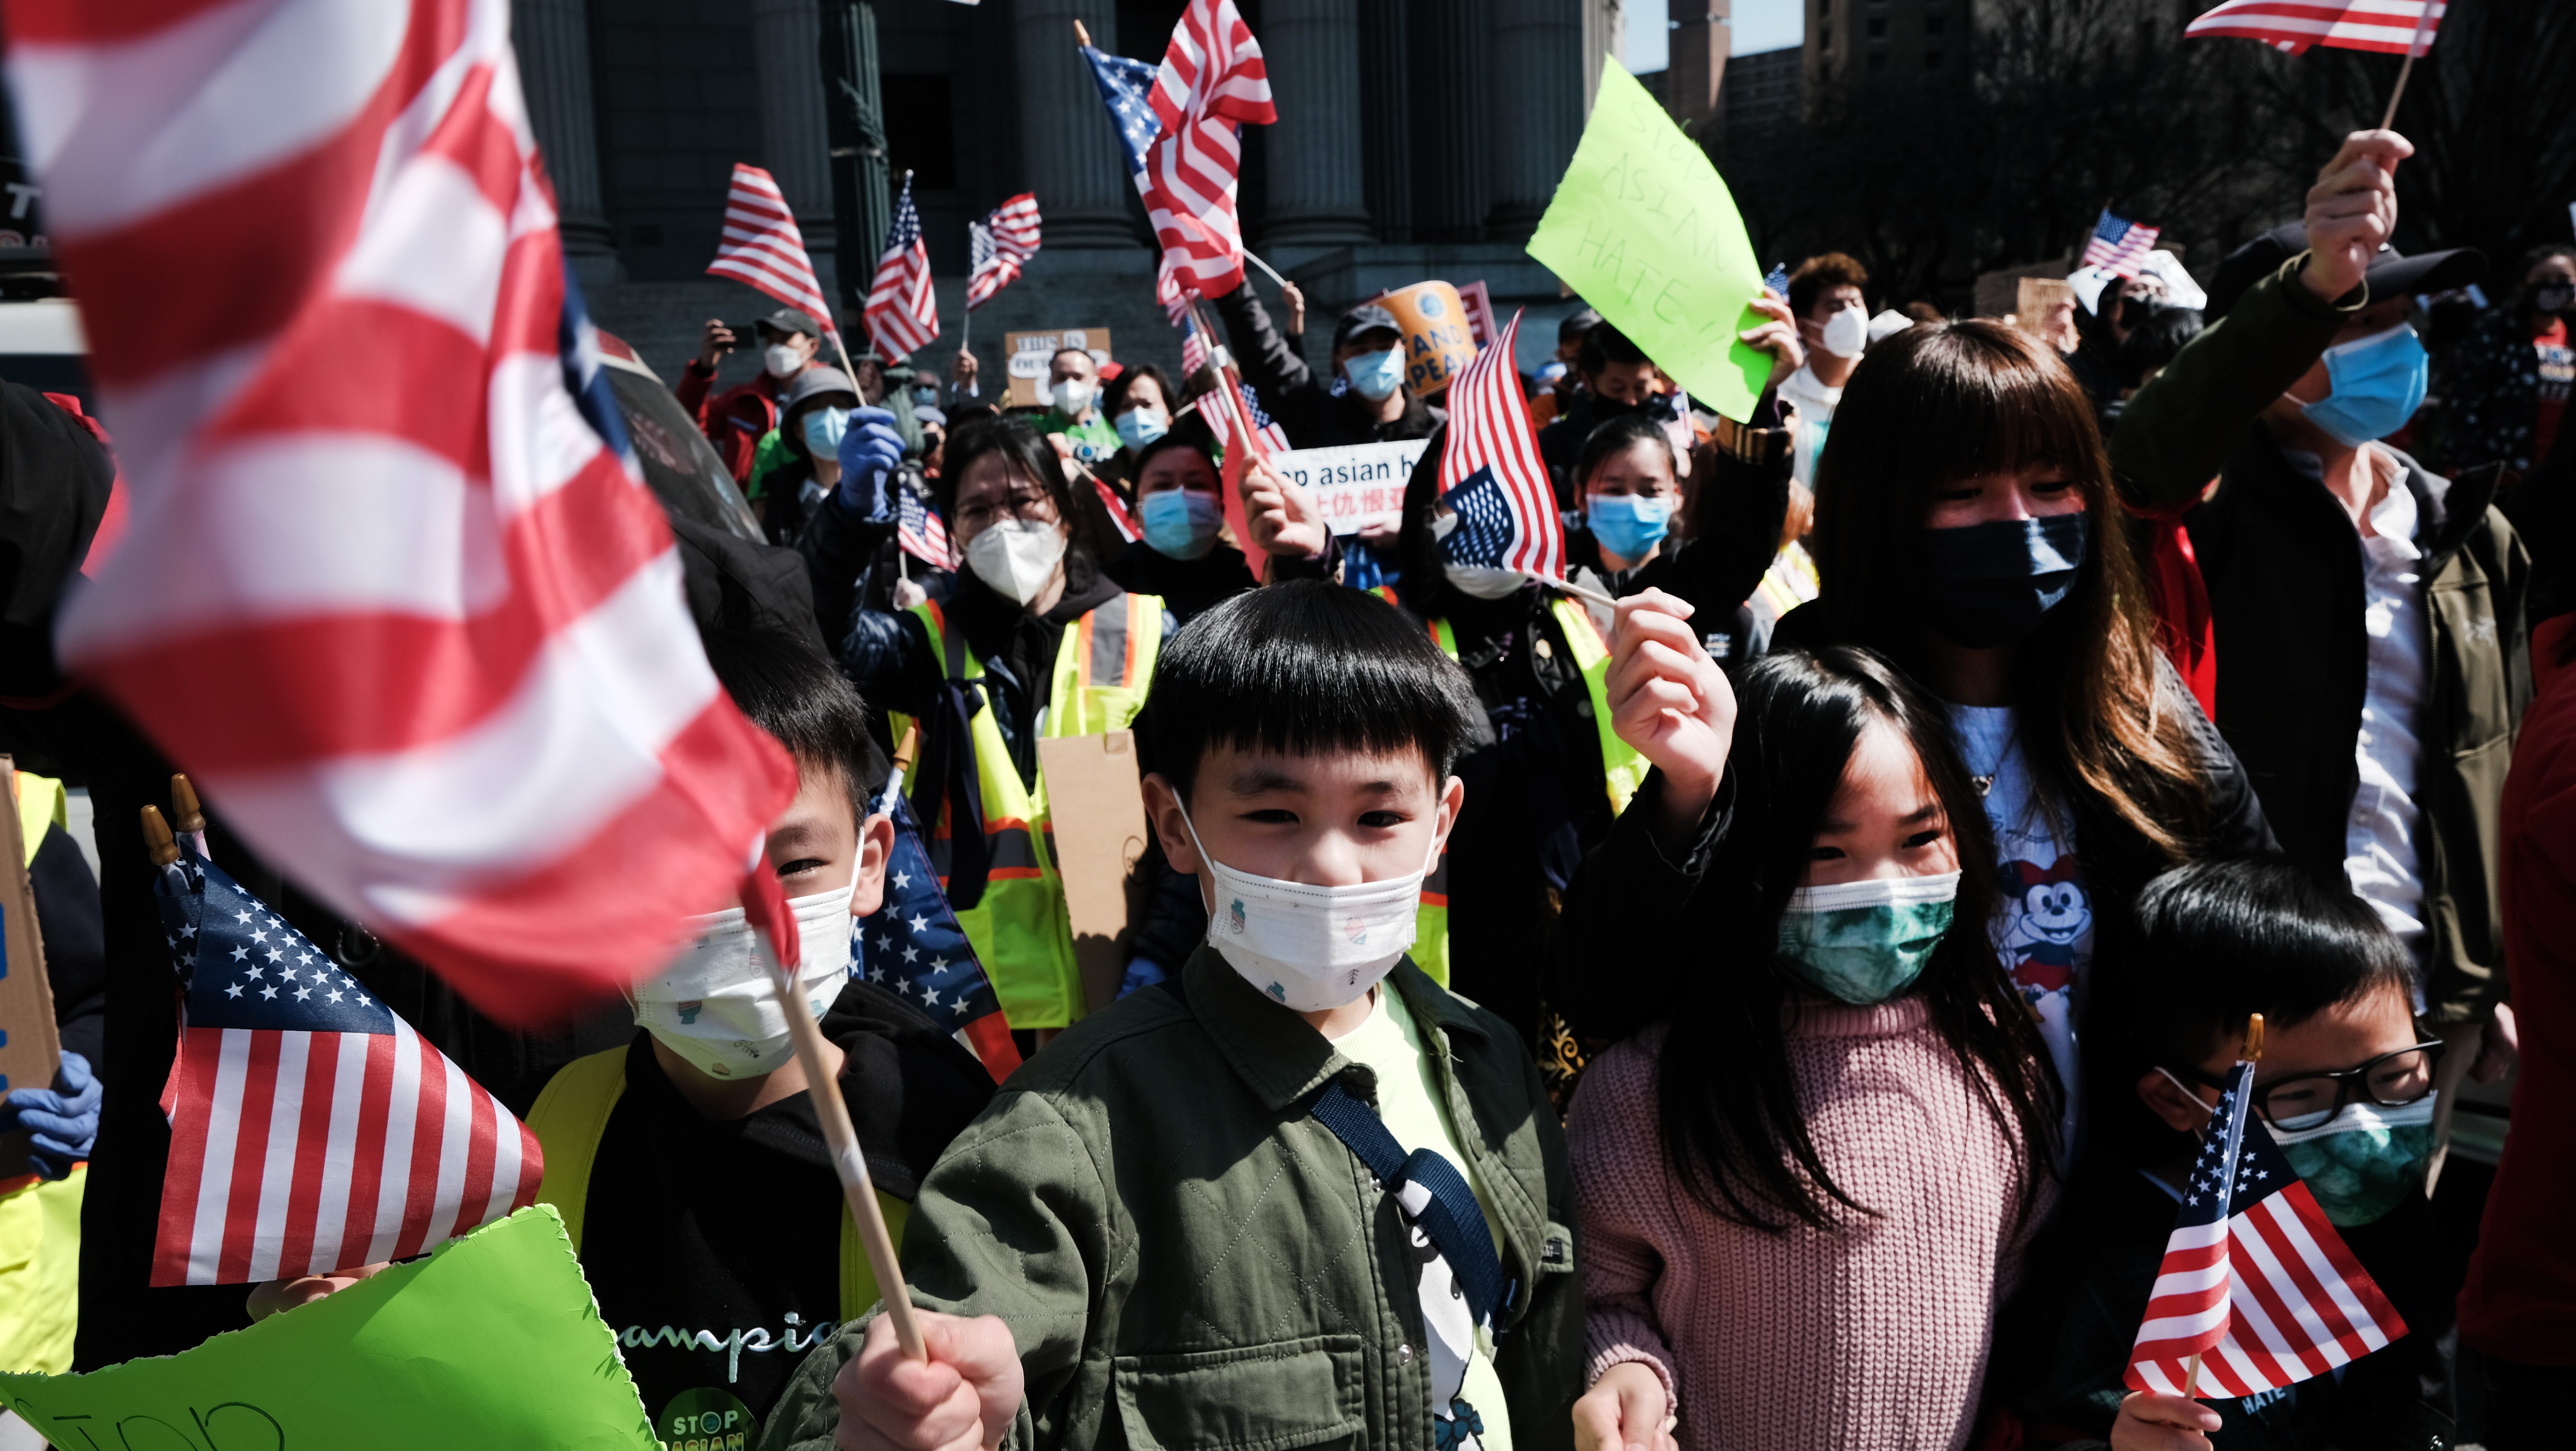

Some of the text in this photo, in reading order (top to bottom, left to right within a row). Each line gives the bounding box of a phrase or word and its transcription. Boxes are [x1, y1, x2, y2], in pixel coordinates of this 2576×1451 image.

[1631, 101, 1711, 182] STOP
[1603, 152, 1728, 272] ASIAN
[1404, 324, 1463, 362] AND
[1321, 458, 1390, 484] asian
[2242, 1387, 2286, 1416] HATE
[673, 1410, 739, 1435] STOP
